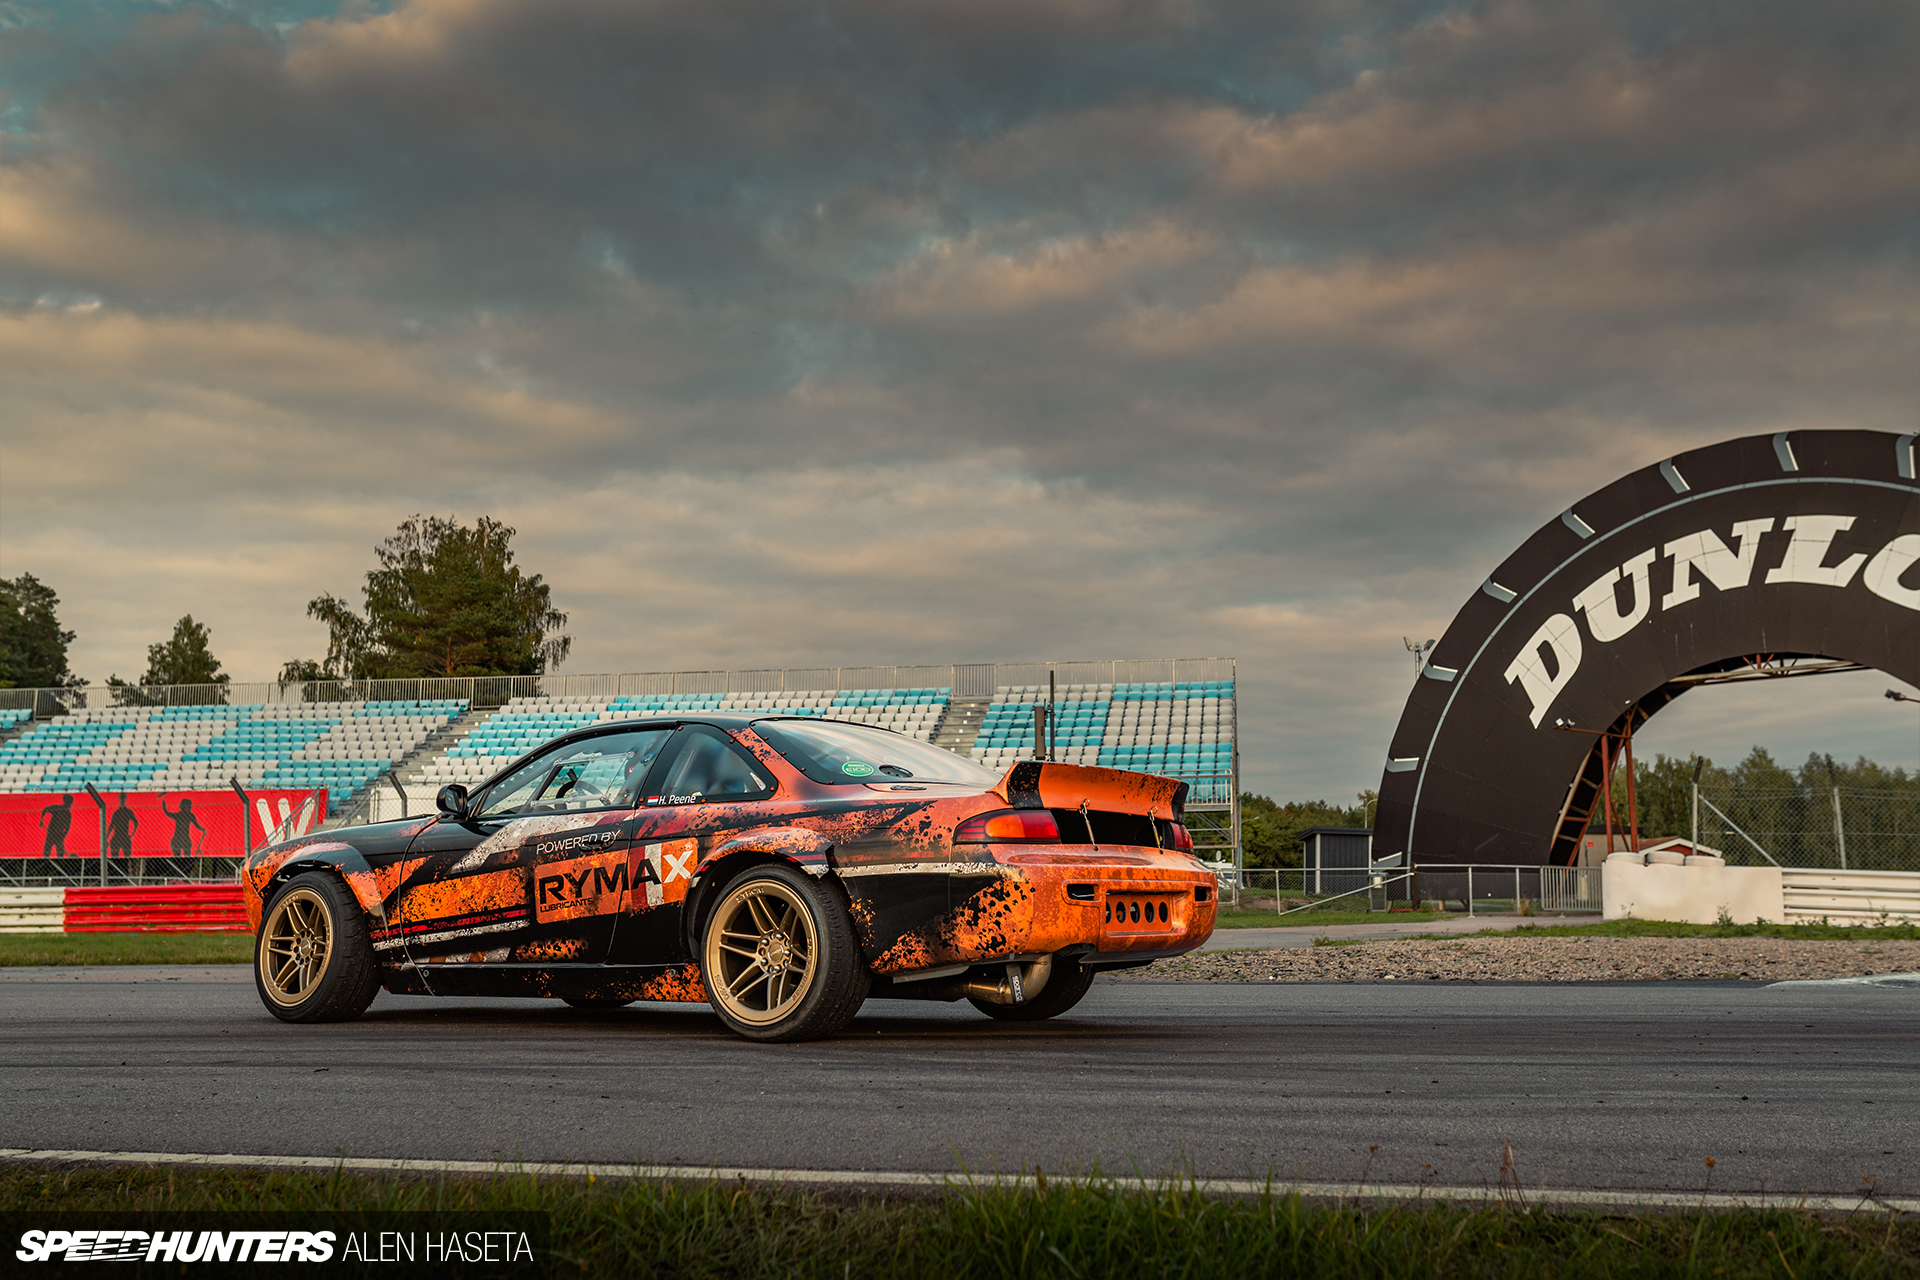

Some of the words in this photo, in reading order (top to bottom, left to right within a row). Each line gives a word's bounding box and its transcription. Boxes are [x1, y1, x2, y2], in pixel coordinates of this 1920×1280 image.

[658, 795, 667, 805] H.
[668, 794, 697, 804] Peene
[536, 833, 598, 854] POWERED
[600, 829, 621, 844] BY
[538, 850, 694, 905] RYMAX
[540, 897, 593, 913] LUBRICANTS
